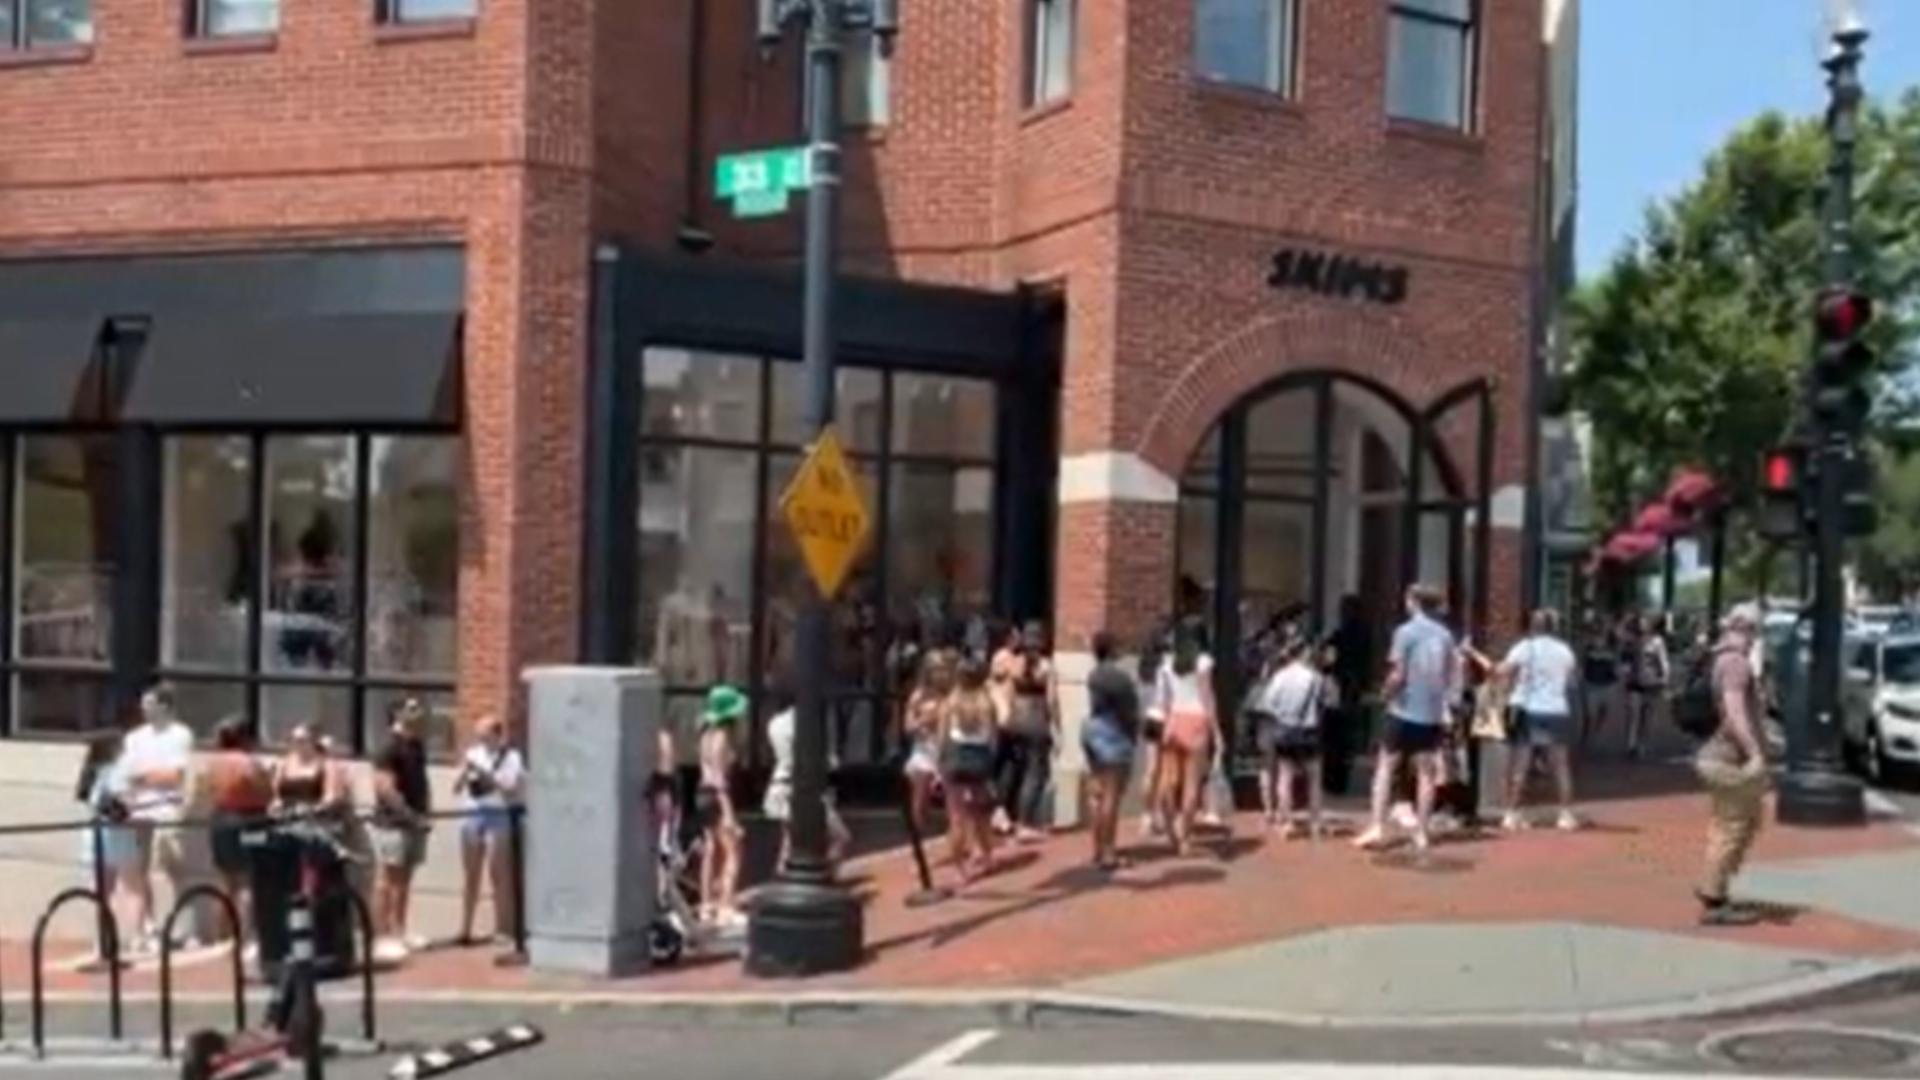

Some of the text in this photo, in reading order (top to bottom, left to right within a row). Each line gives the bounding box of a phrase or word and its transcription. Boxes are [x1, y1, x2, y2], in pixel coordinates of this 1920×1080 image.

[1267, 250, 1408, 304] SKIMS
[814, 464, 844, 496] NO
[794, 504, 861, 543] OUTLET
